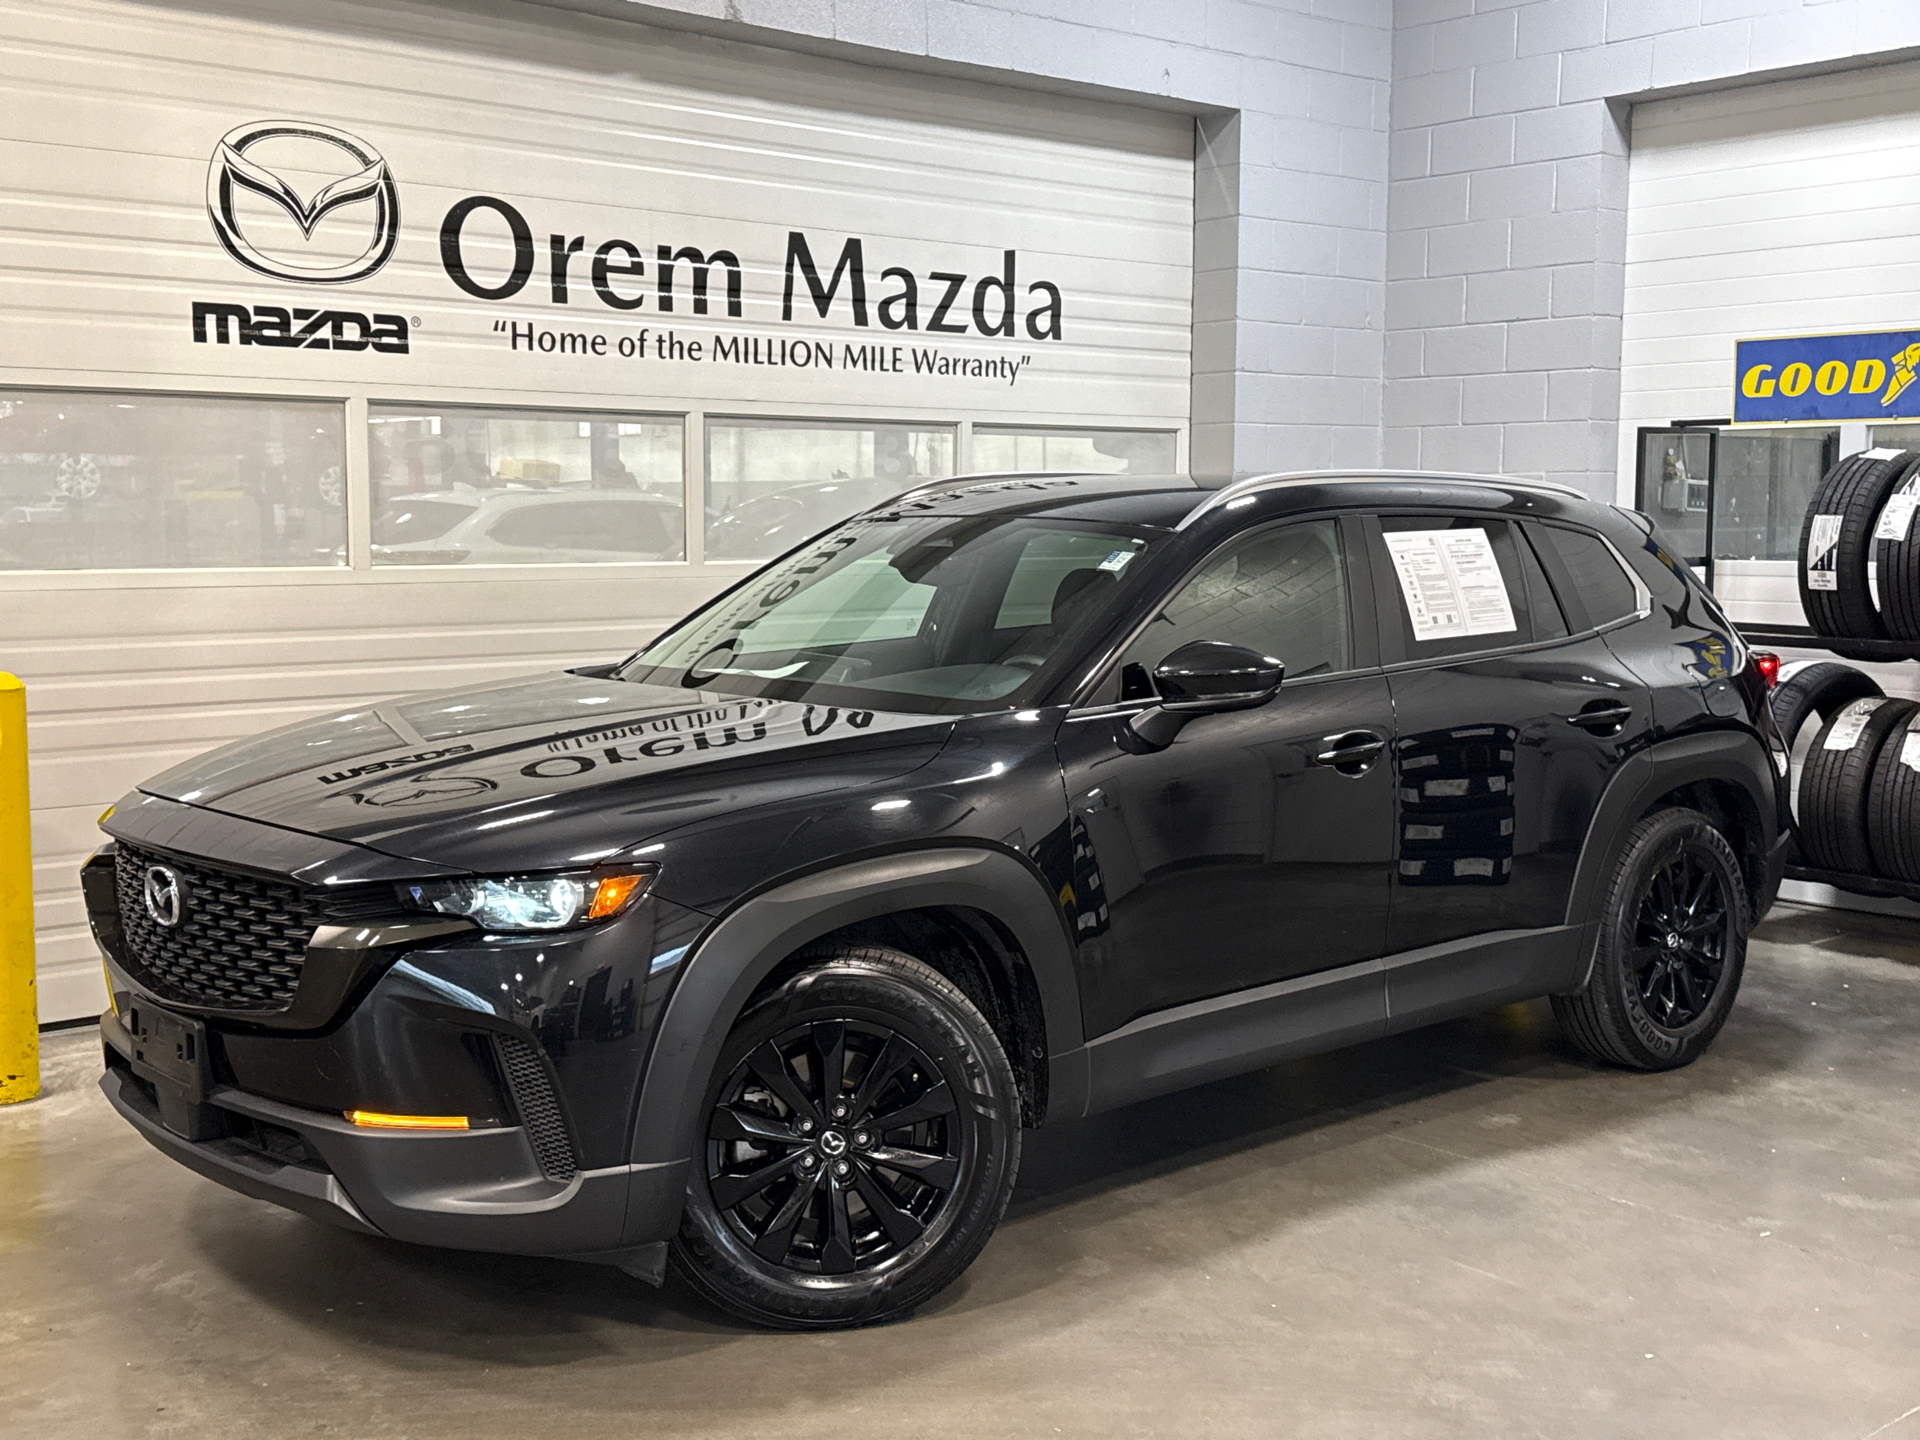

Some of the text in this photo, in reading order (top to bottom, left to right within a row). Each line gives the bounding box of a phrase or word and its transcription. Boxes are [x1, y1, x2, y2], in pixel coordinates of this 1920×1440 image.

[439, 195, 1063, 341] Orem Mazda
[618, 329, 650, 358] of
[656, 331, 703, 361] the
[712, 335, 833, 369] MILLION
[843, 344, 904, 373] MILE
